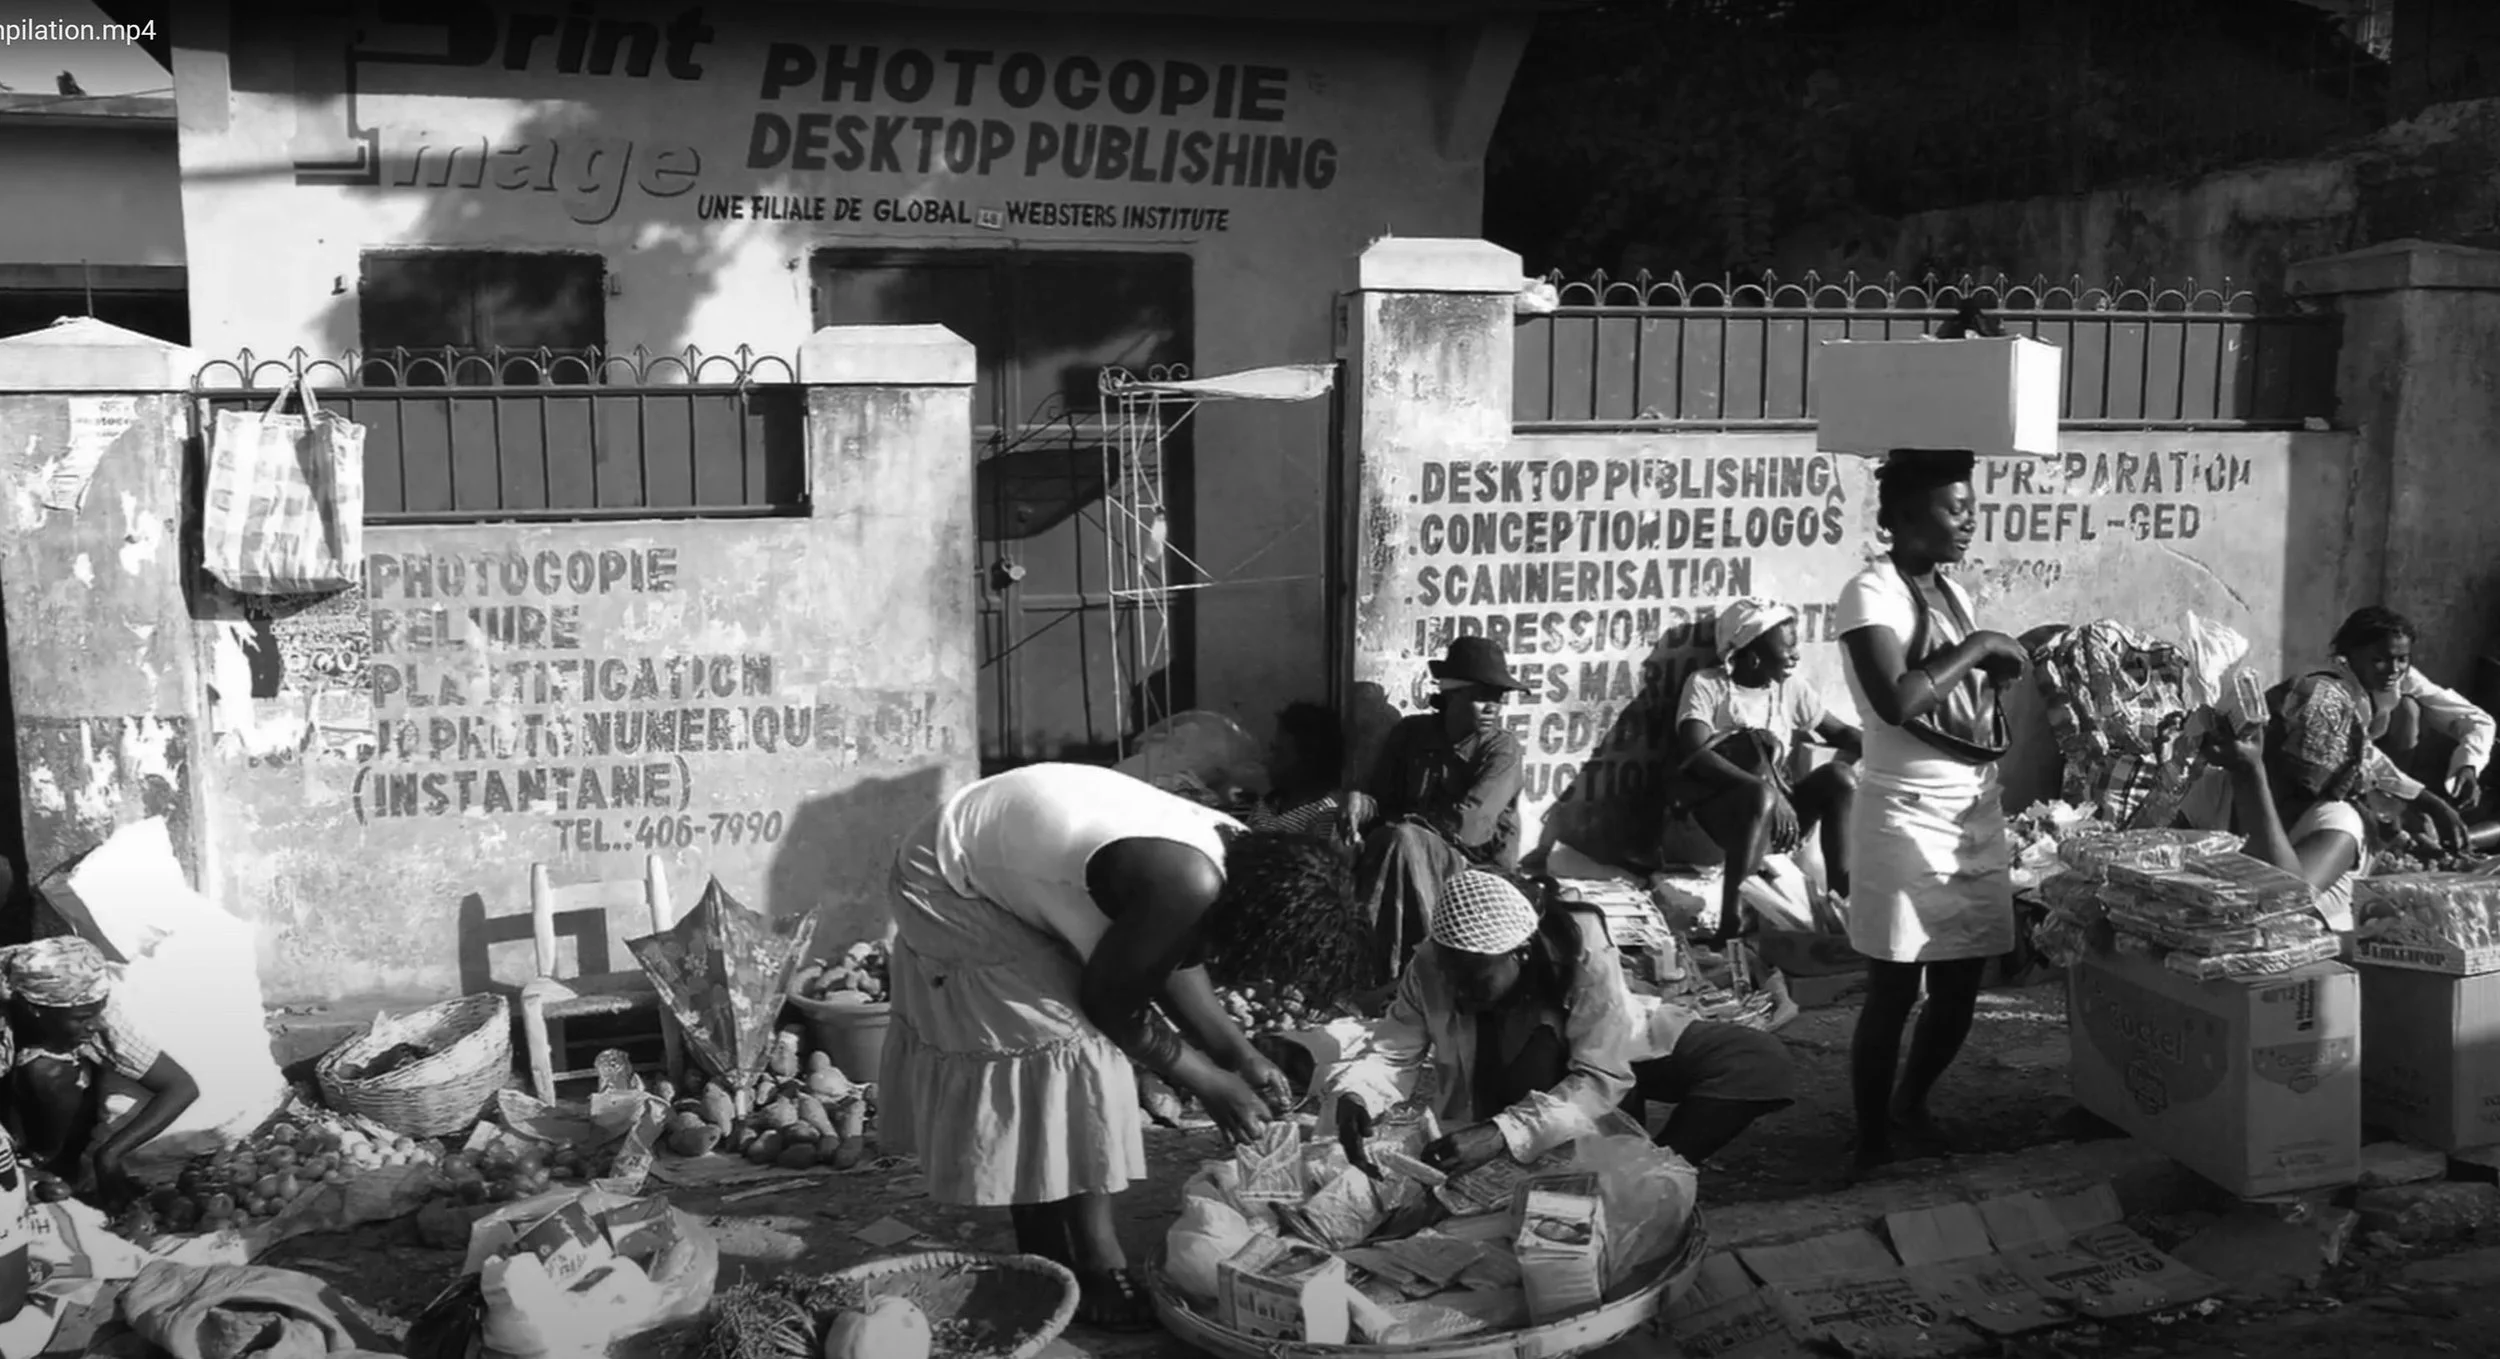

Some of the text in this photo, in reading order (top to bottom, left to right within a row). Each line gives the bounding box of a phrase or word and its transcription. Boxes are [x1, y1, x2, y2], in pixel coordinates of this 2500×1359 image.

[759, 42, 1288, 122] PHOTOCOPIE
[746, 112, 1338, 190] DESKTOP PUBLISHING
[697, 195, 744, 221] UNE
[750, 195, 826, 221] FILIALE
[833, 198, 863, 222] DE
[873, 198, 972, 224] GLOBAL
[1006, 200, 1117, 228] WEBSTERS
[1122, 204, 1230, 232] INSTITUTE
[1604, 456, 1830, 501] PUBLISHING
[1667, 507, 1715, 550] DE
[1721, 505, 1844, 549] LOGOS
[369, 547, 679, 599] PHOTOCOPIE
[372, 653, 774, 709] PLATIFICATION
[352, 753, 692, 826] (INSTANTANE)
